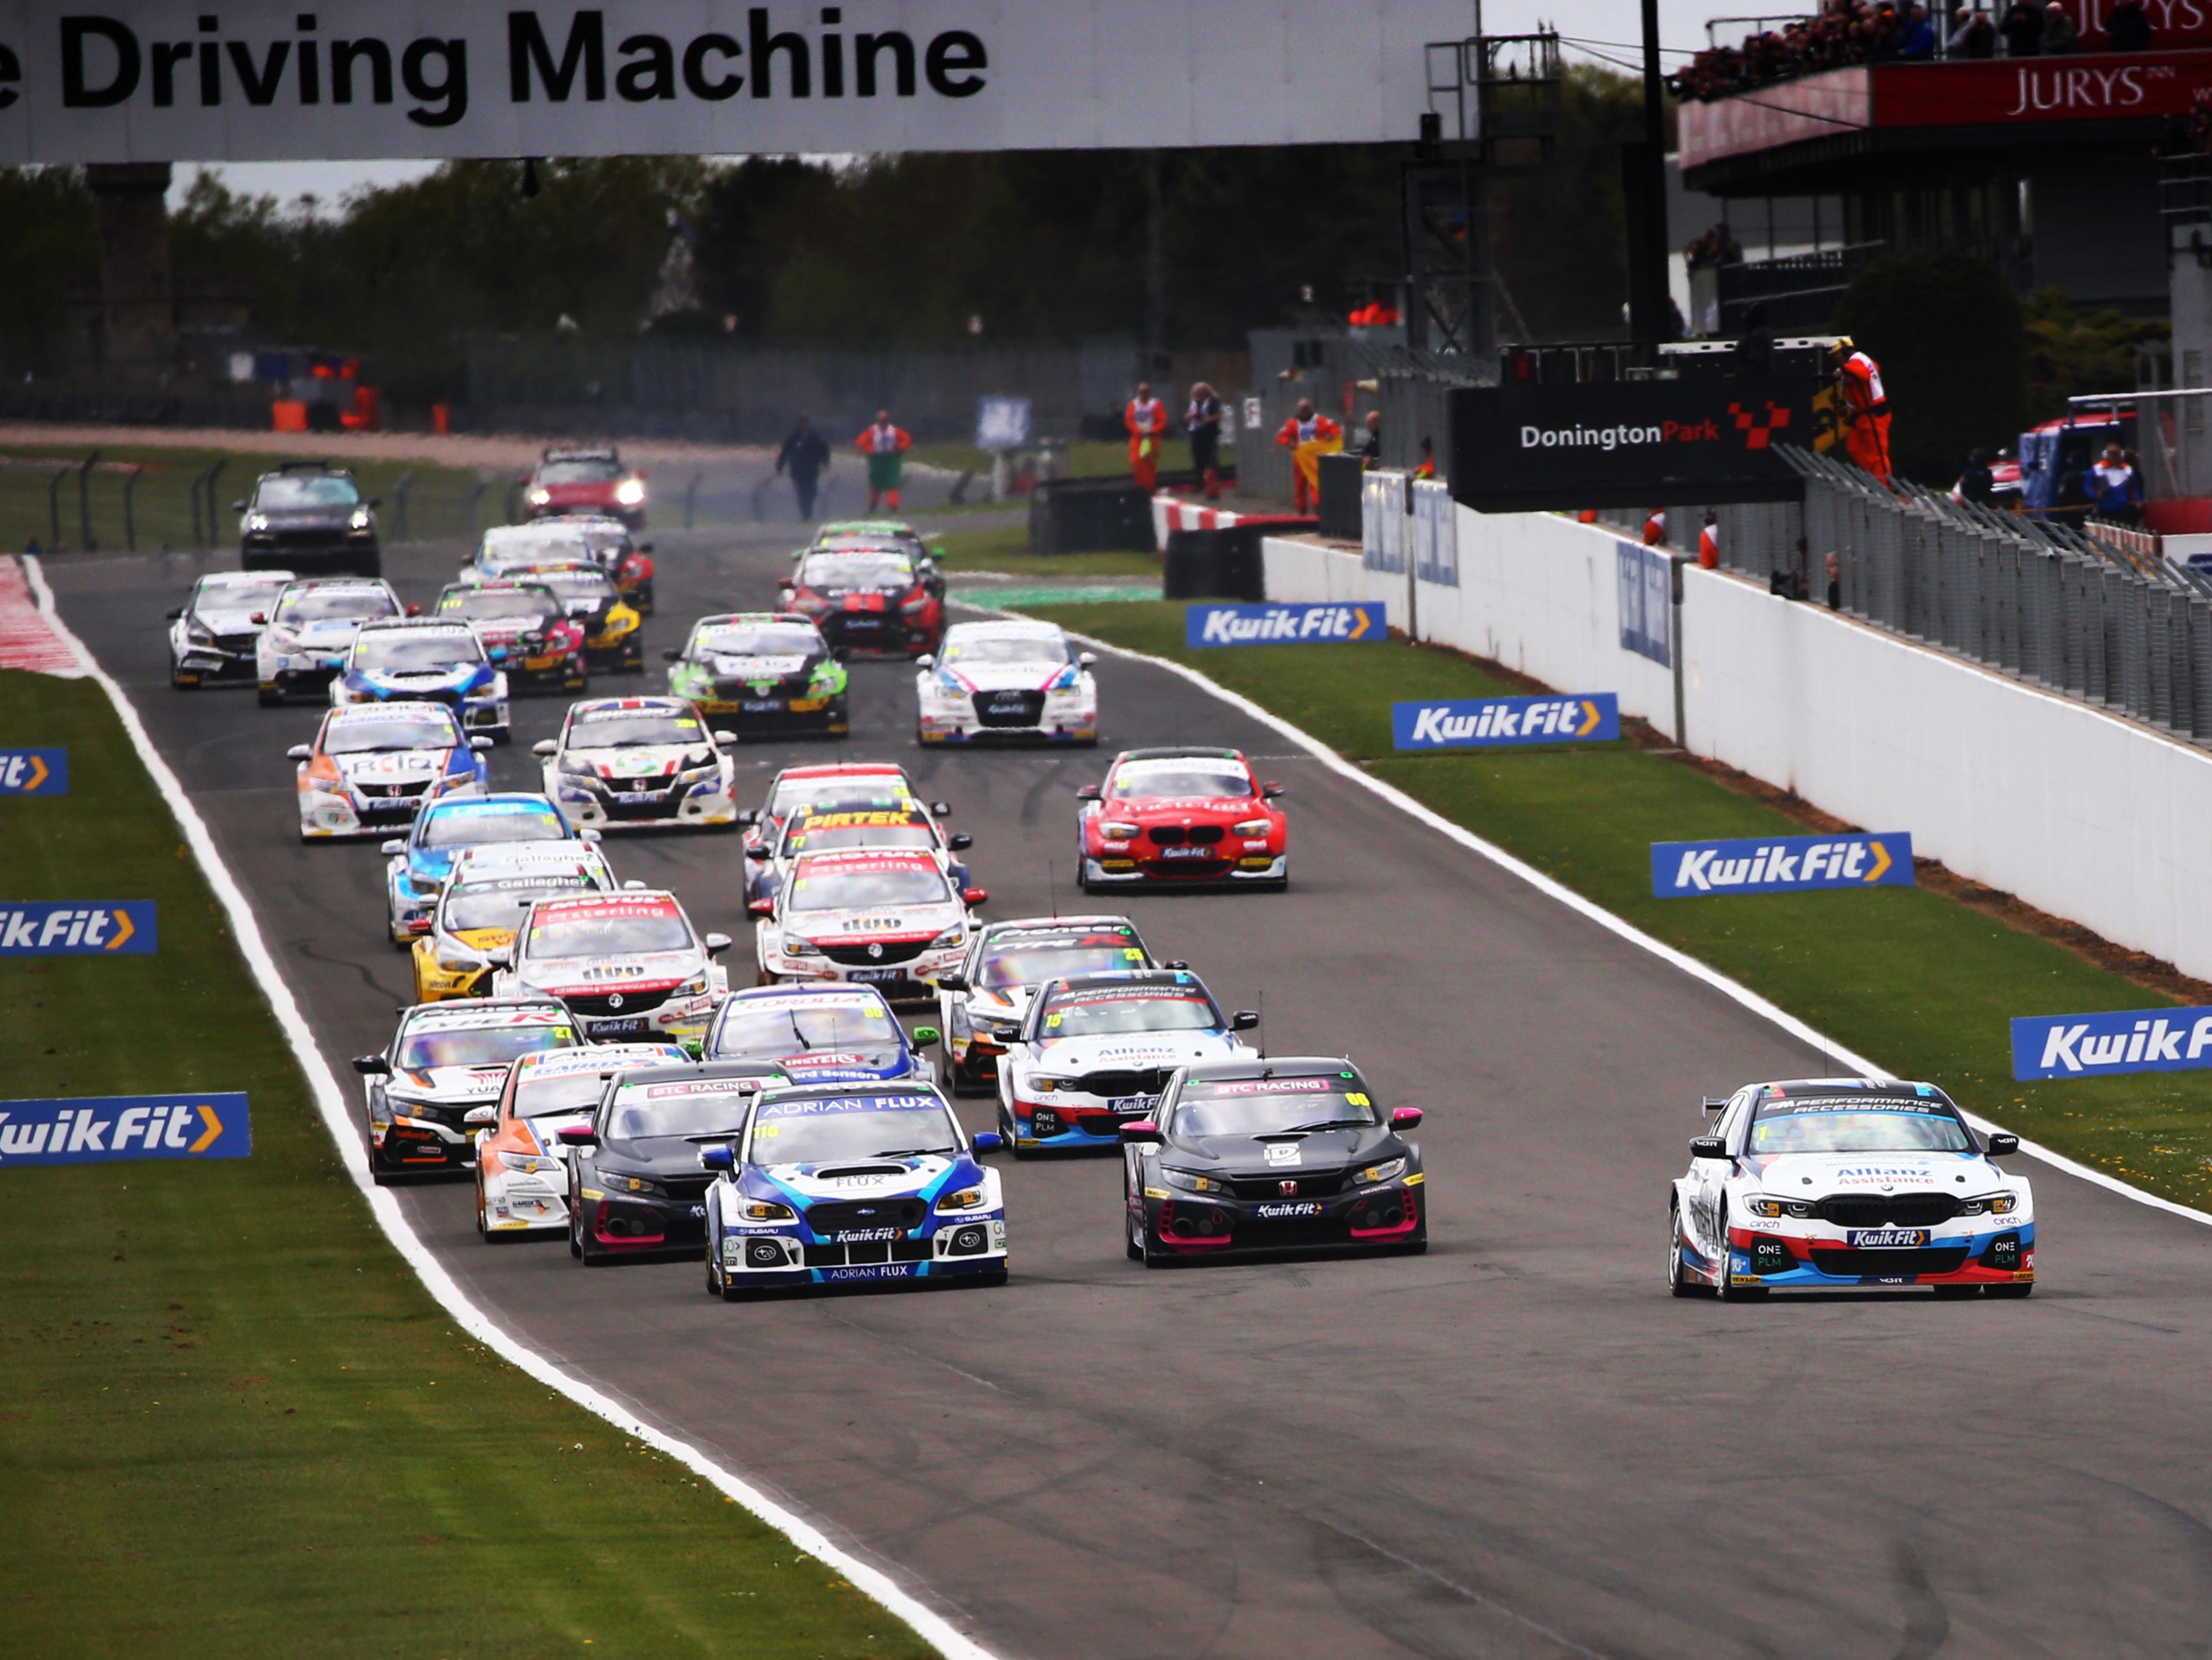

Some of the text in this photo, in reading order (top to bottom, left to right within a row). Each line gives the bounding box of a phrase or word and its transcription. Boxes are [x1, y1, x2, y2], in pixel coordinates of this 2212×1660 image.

[61, 15, 468, 127] Driving
[509, 9, 988, 104] Machine
[2006, 66, 2145, 116] JURYS
[803, 811, 911, 829] PIRTEK
[498, 877, 587, 888] Gallagher
[549, 896, 661, 910] MOTUL
[570, 906, 664, 919] sterling
[1123, 948, 1144, 960] 25
[746, 997, 862, 1009] COROLLA
[1046, 1013, 1062, 1028] 15
[553, 1026, 572, 1039] 27
[1098, 1047, 1176, 1057] Allianz
[1098, 1054, 1177, 1063] Assistance
[816, 1070, 879, 1080] Sensors
[651, 1081, 752, 1095] BTC RACING
[1218, 1080, 1321, 1094] BTC RACING
[1034, 1093, 1058, 1101] cinch
[1796, 1097, 1943, 1109] PERFORMANCE
[763, 1095, 936, 1116] ADRIAN FLUX
[1794, 1104, 1930, 1113] ACCESSORIES
[1036, 1112, 1055, 1122] ONE
[0, 1105, 194, 1159] wikFit
[1035, 1123, 1055, 1132] PLM
[1758, 1126, 1768, 1142] 1
[1836, 1168, 1933, 1177] Allianz
[836, 1176, 885, 1188] FLUX
[1838, 1176, 1934, 1185] Assistance
[1749, 1220, 1781, 1229] cinch
[1993, 1216, 2022, 1226] cinch
[1757, 1245, 1782, 1255] ONE
[1995, 1242, 2015, 1251] ONE
[1758, 1257, 1782, 1267] PLM
[1995, 1255, 2015, 1264] PLM
[831, 1266, 907, 1279] ADRIAN FLUX
